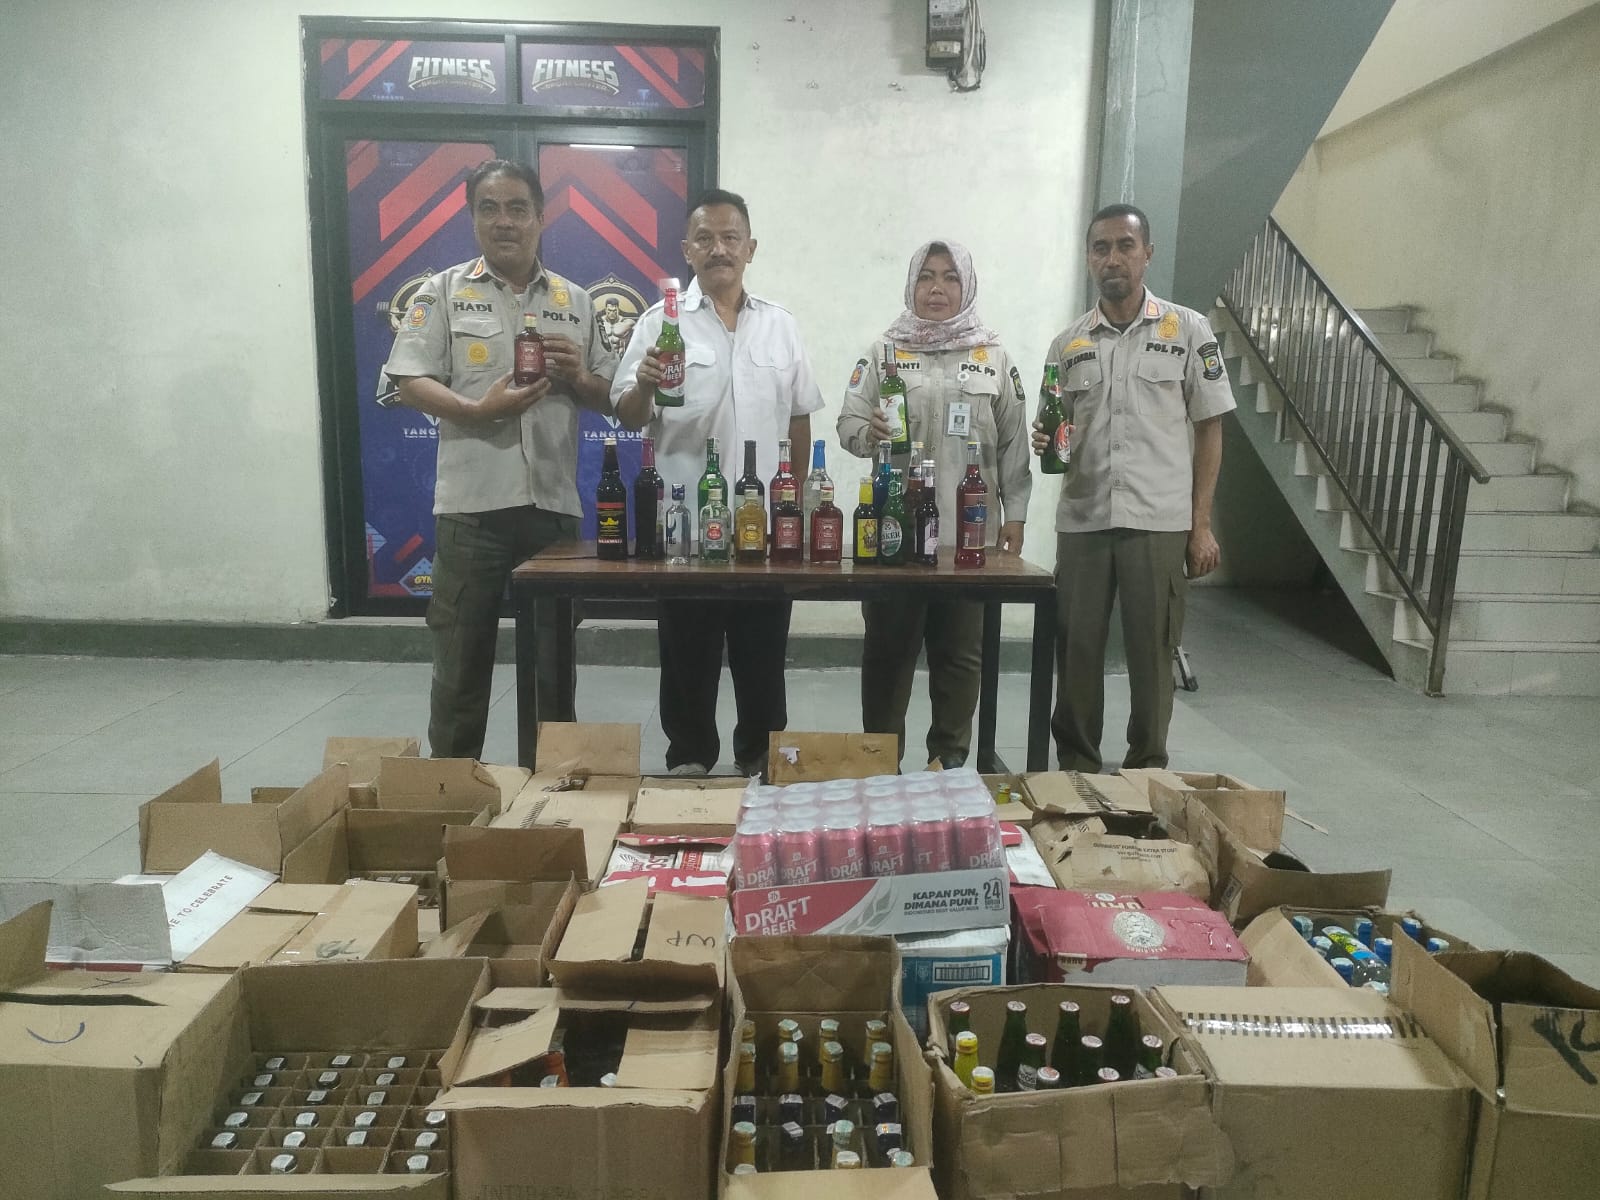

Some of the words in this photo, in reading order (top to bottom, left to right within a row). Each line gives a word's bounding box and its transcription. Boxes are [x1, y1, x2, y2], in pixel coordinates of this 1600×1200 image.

[408, 56, 497, 85] FITNESS
[532, 59, 620, 87] FITNESS
[453, 302, 493, 312] HADI
[543, 310, 565, 321] POL
[1146, 342, 1169, 353] POL
[1171, 345, 1186, 357] PP
[961, 363, 981, 374] POL
[984, 366, 996, 378] PP
[177, 907, 192, 917] TO
[190, 875, 233, 908] CELEBRATE
[913, 890, 951, 900] KAPAN
[953, 888, 979, 899] PUN,
[983, 881, 1001, 899] 24
[904, 900, 947, 911] DIMANA
[745, 896, 812, 932] DRAFT
[762, 919, 798, 937] BEER
